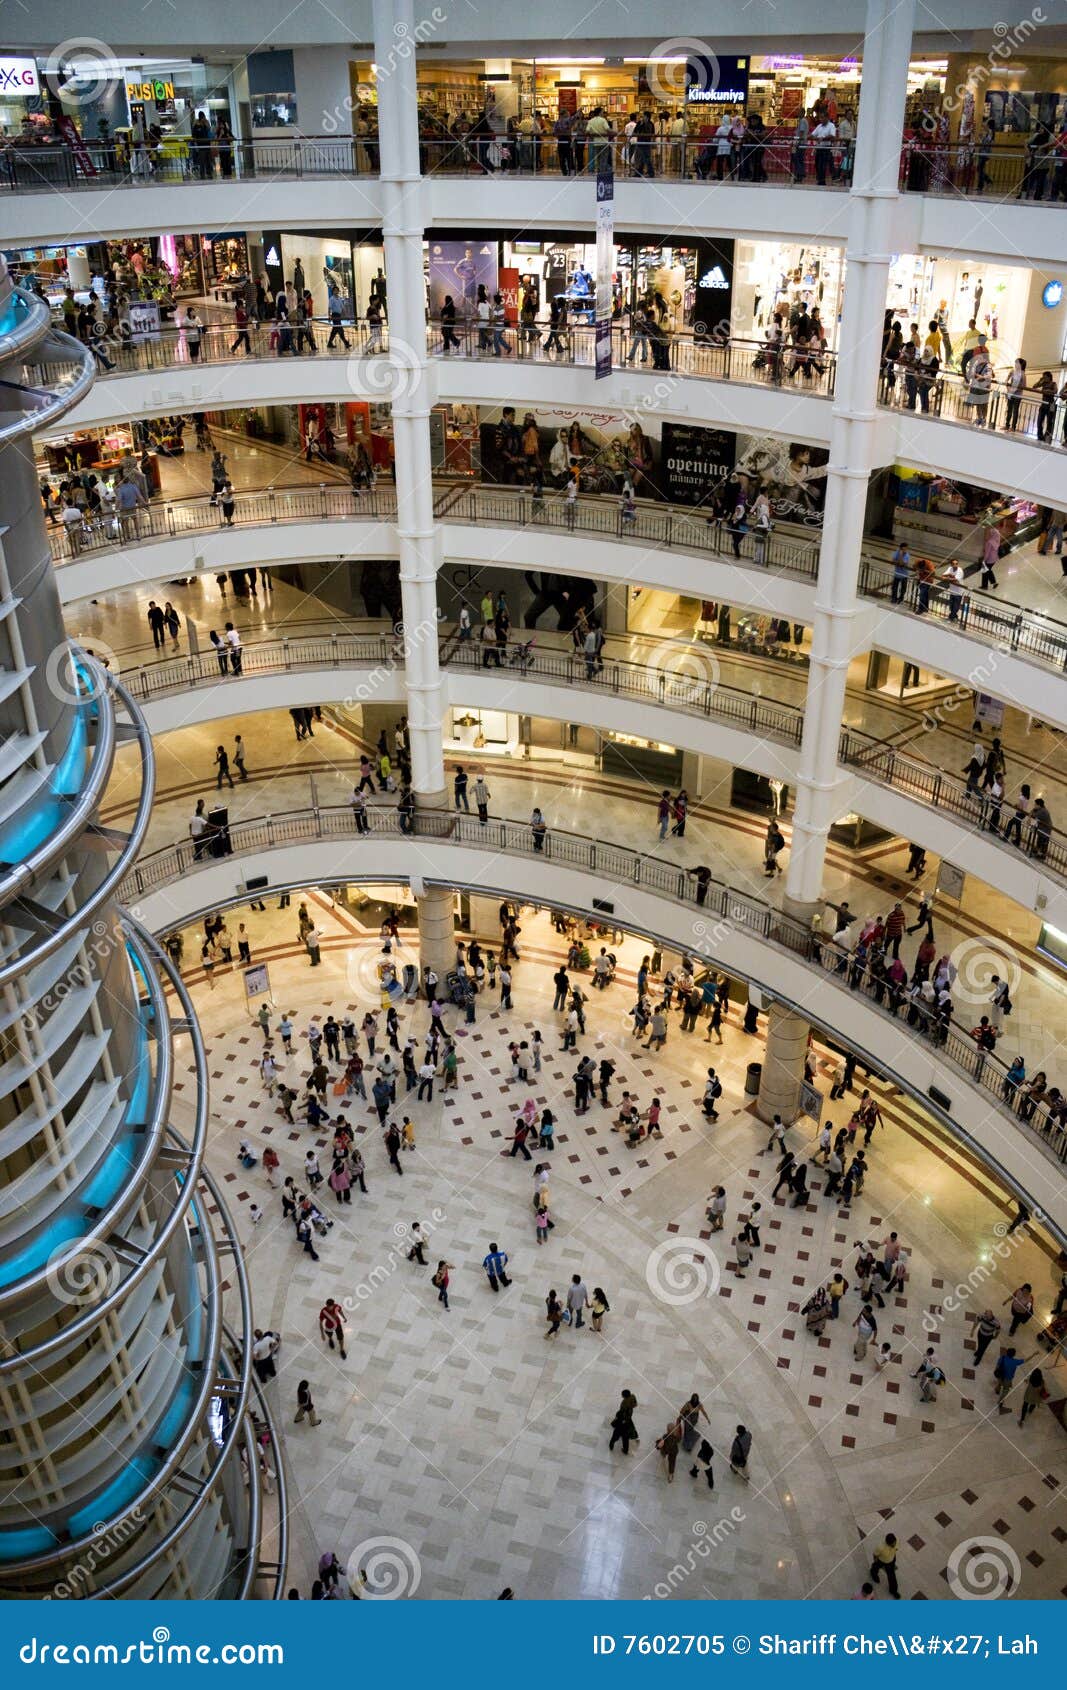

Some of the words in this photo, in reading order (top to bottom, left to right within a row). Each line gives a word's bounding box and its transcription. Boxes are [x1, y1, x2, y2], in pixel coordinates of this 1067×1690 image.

[127, 80, 175, 101] FUSION
[688, 88, 745, 104] Kinokuniya
[553, 254, 565, 267] 23
[699, 279, 729, 290] adidas
[499, 292, 518, 305] SAL
[667, 458, 729, 480] opening
